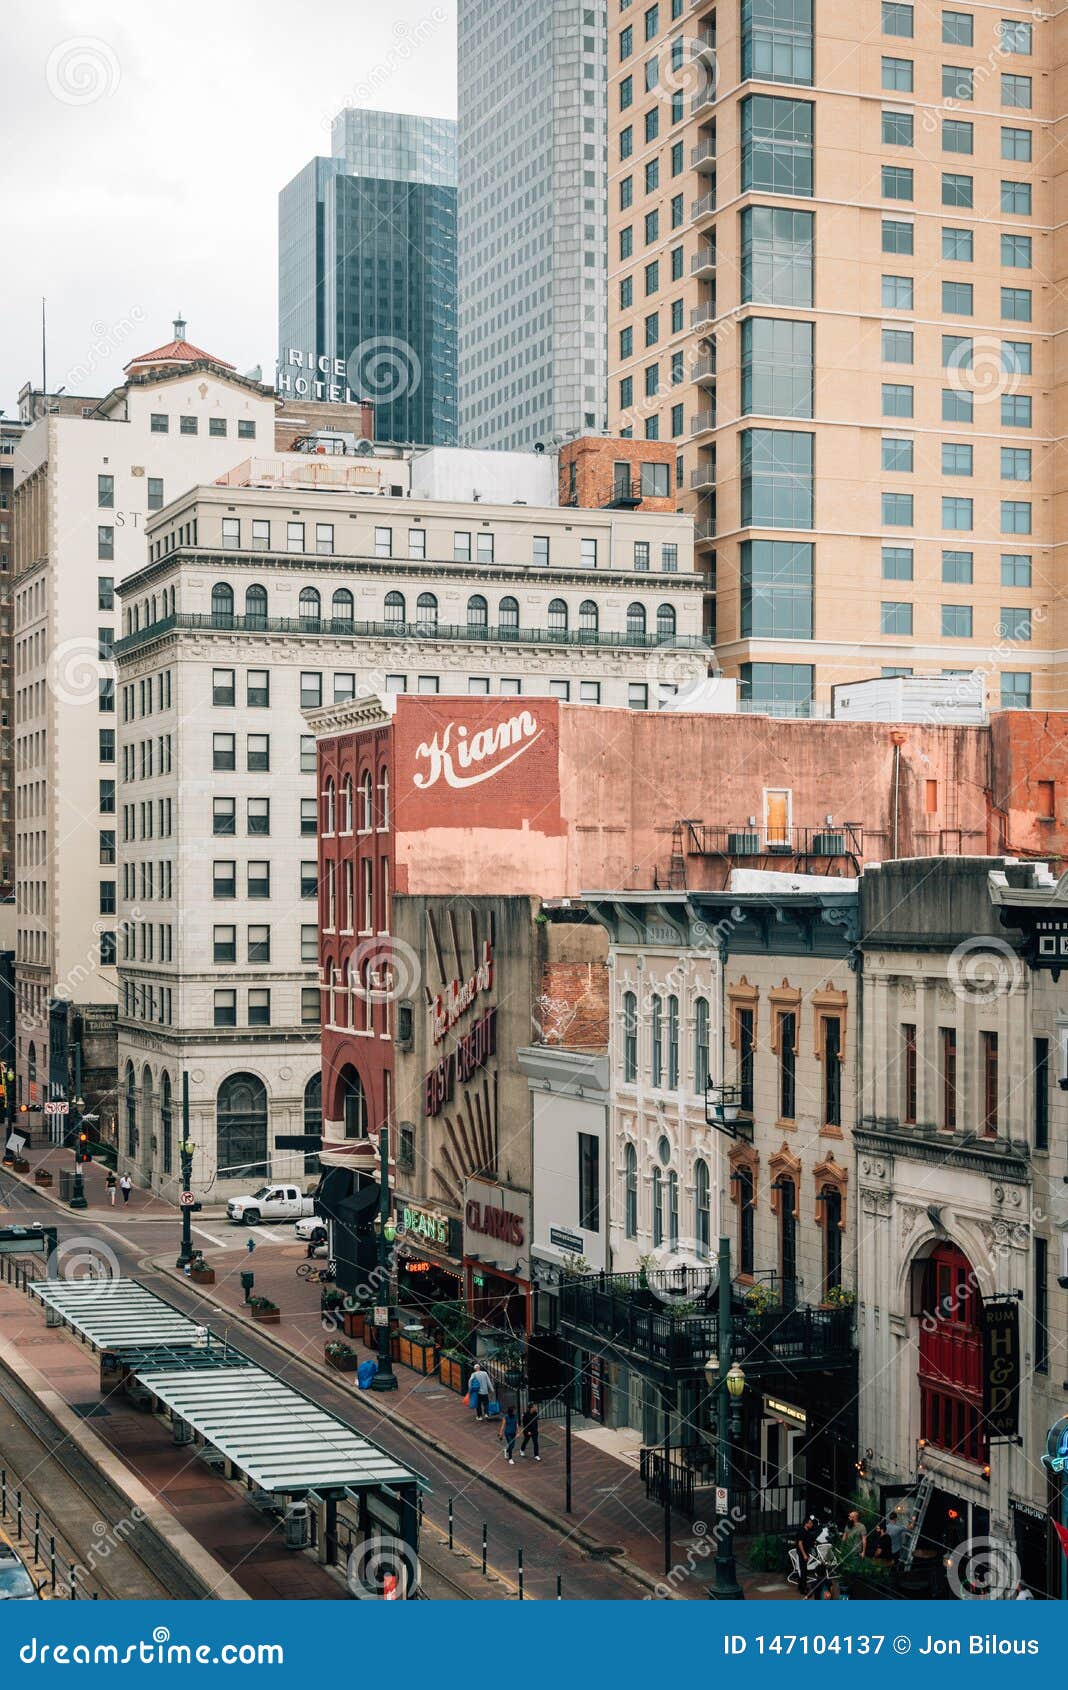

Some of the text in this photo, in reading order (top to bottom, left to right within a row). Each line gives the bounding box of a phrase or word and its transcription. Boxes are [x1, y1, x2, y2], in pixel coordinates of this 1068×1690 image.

[288, 348, 346, 376] RICE
[278, 373, 358, 404] HOTEL
[413, 711, 544, 788] Kiam
[425, 1055, 453, 1117] EASY
[466, 1200, 524, 1246] CLARKS
[986, 1311, 1015, 1323] RUM
